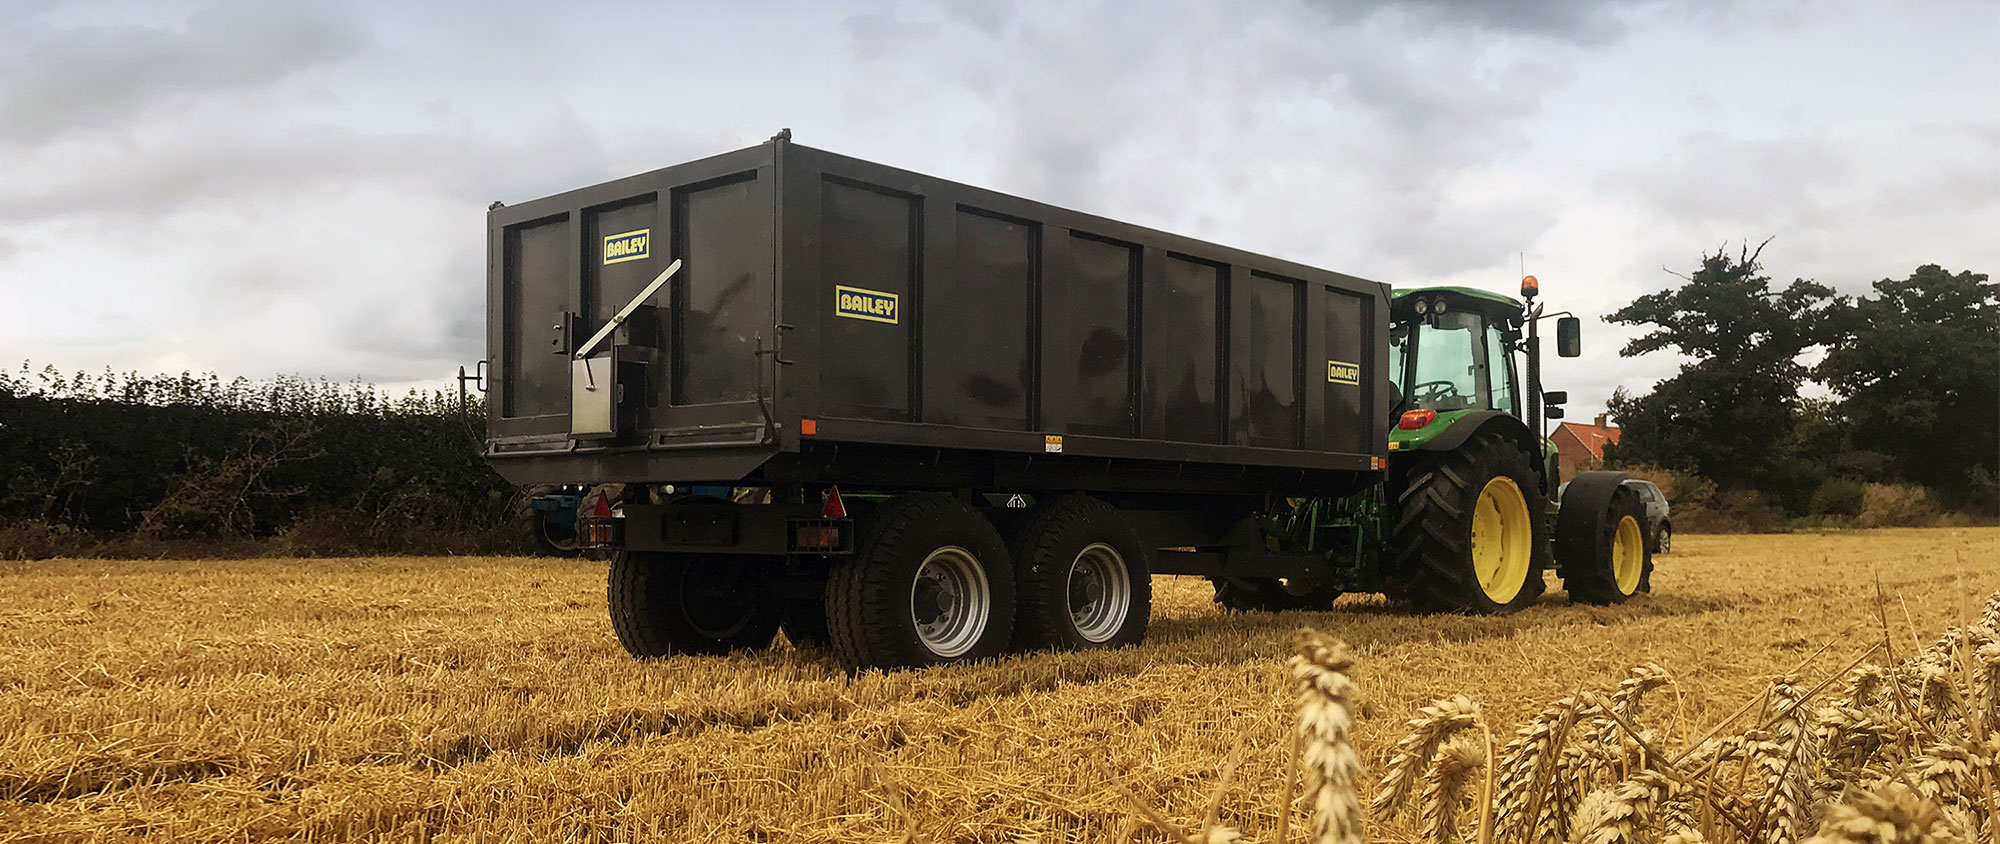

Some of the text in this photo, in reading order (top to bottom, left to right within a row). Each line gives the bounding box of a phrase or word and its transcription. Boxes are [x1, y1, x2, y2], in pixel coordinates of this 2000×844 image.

[607, 236, 646, 258] BAILEY
[841, 294, 894, 316] BAILEY
[1330, 366, 1357, 380] BAILEY
